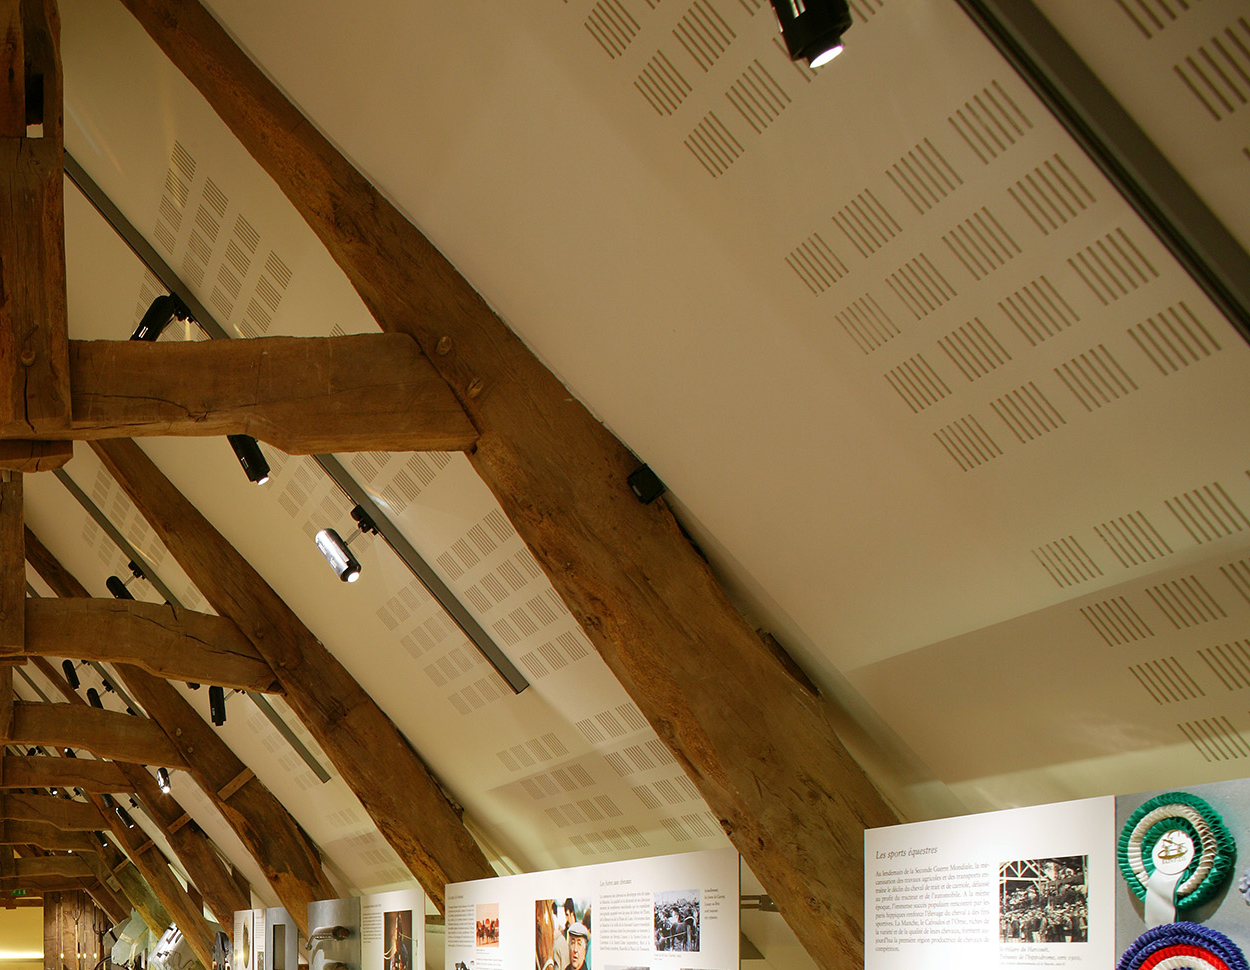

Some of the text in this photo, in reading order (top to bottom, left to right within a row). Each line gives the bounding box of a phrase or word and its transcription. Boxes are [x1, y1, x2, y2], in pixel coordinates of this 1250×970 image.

[876, 847, 937, 860] Les sports équestres
